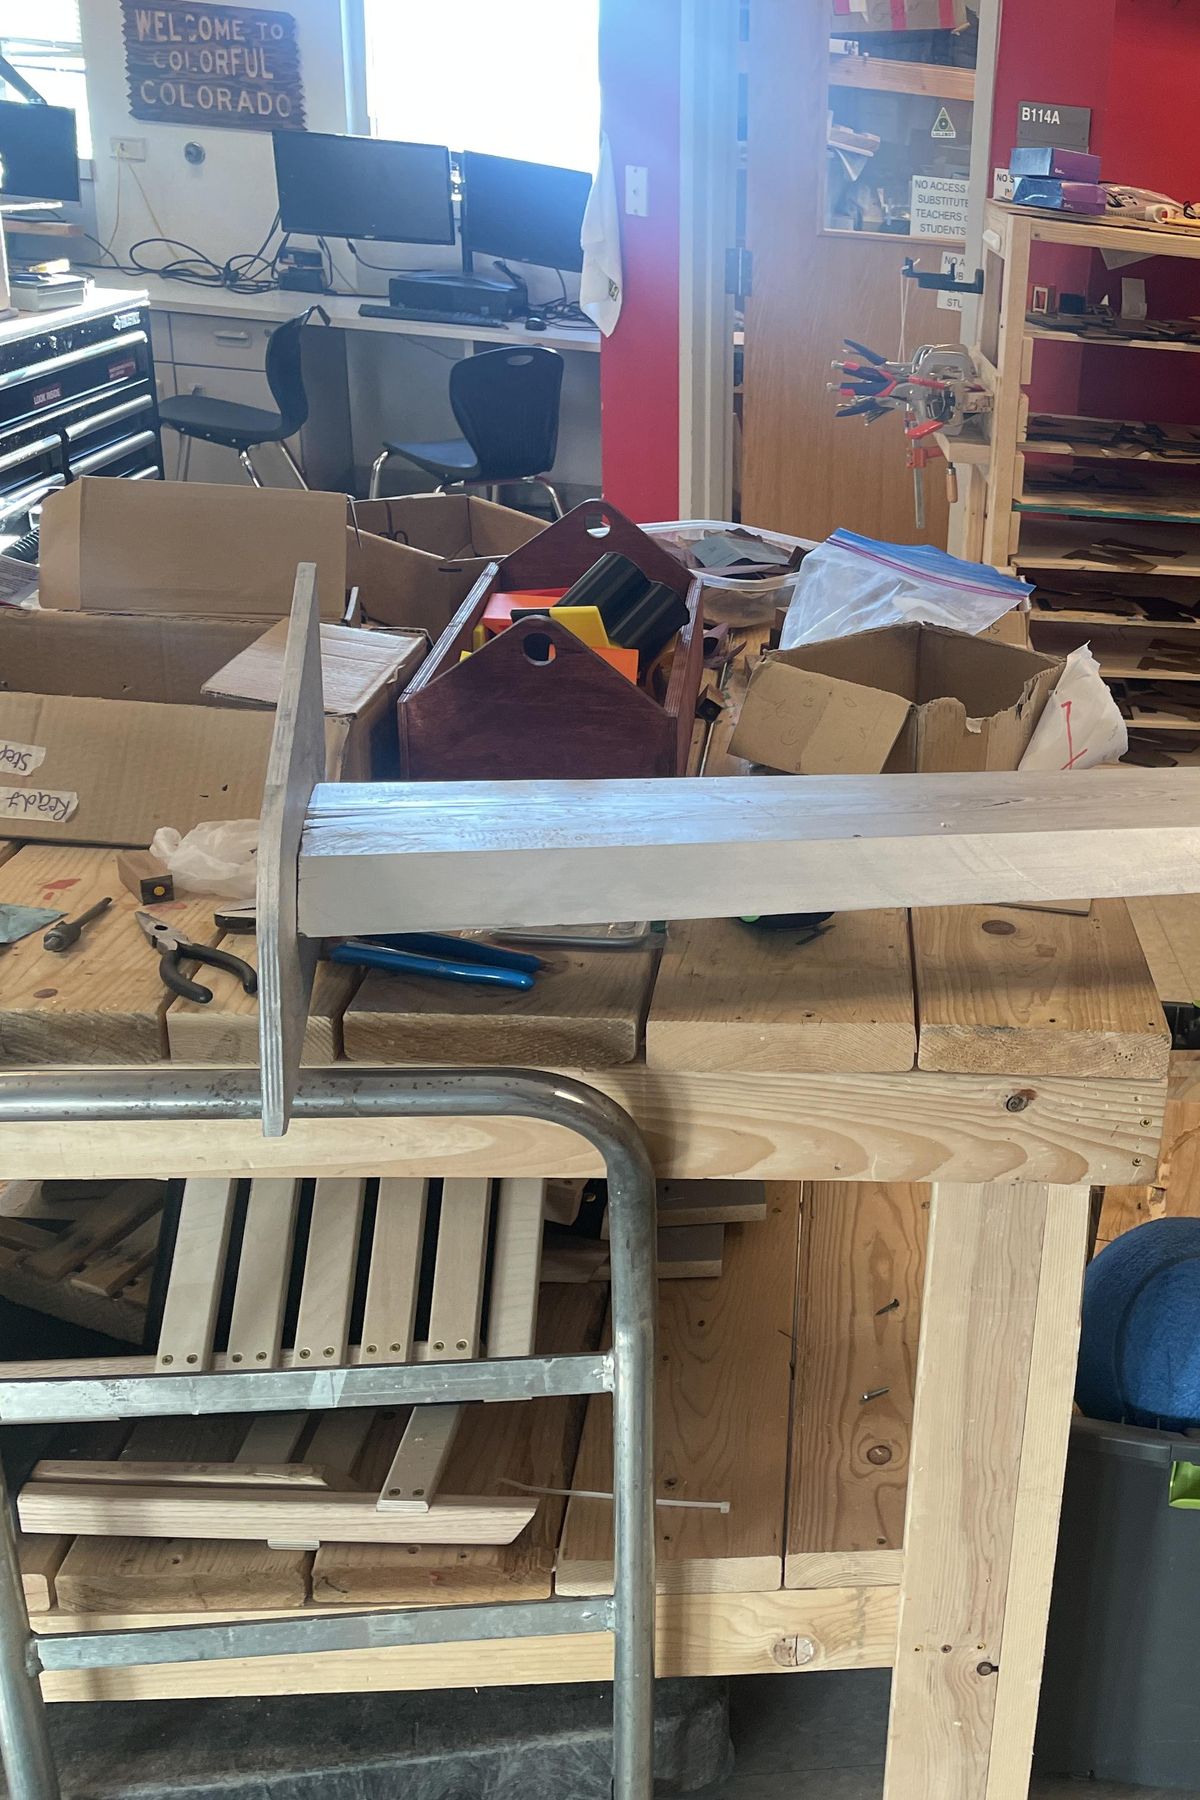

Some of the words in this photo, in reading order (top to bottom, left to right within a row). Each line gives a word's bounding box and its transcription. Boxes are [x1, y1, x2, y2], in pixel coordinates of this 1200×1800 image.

[134, 9, 246, 42] WELCOME
[256, 21, 284, 41] TO
[153, 47, 274, 80] COLORFUL
[140, 80, 292, 118] COLORADO
[1021, 106, 1060, 125] B114A
[996, 173, 1008, 182] NO
[914, 180, 929, 190] NO
[930, 181, 967, 193] ACCESS
[915, 208, 962, 221] TEACHERS
[919, 223, 967, 236] STUDENTS
[944, 255, 958, 265] NO
[5, 791, 71, 821] Ready
